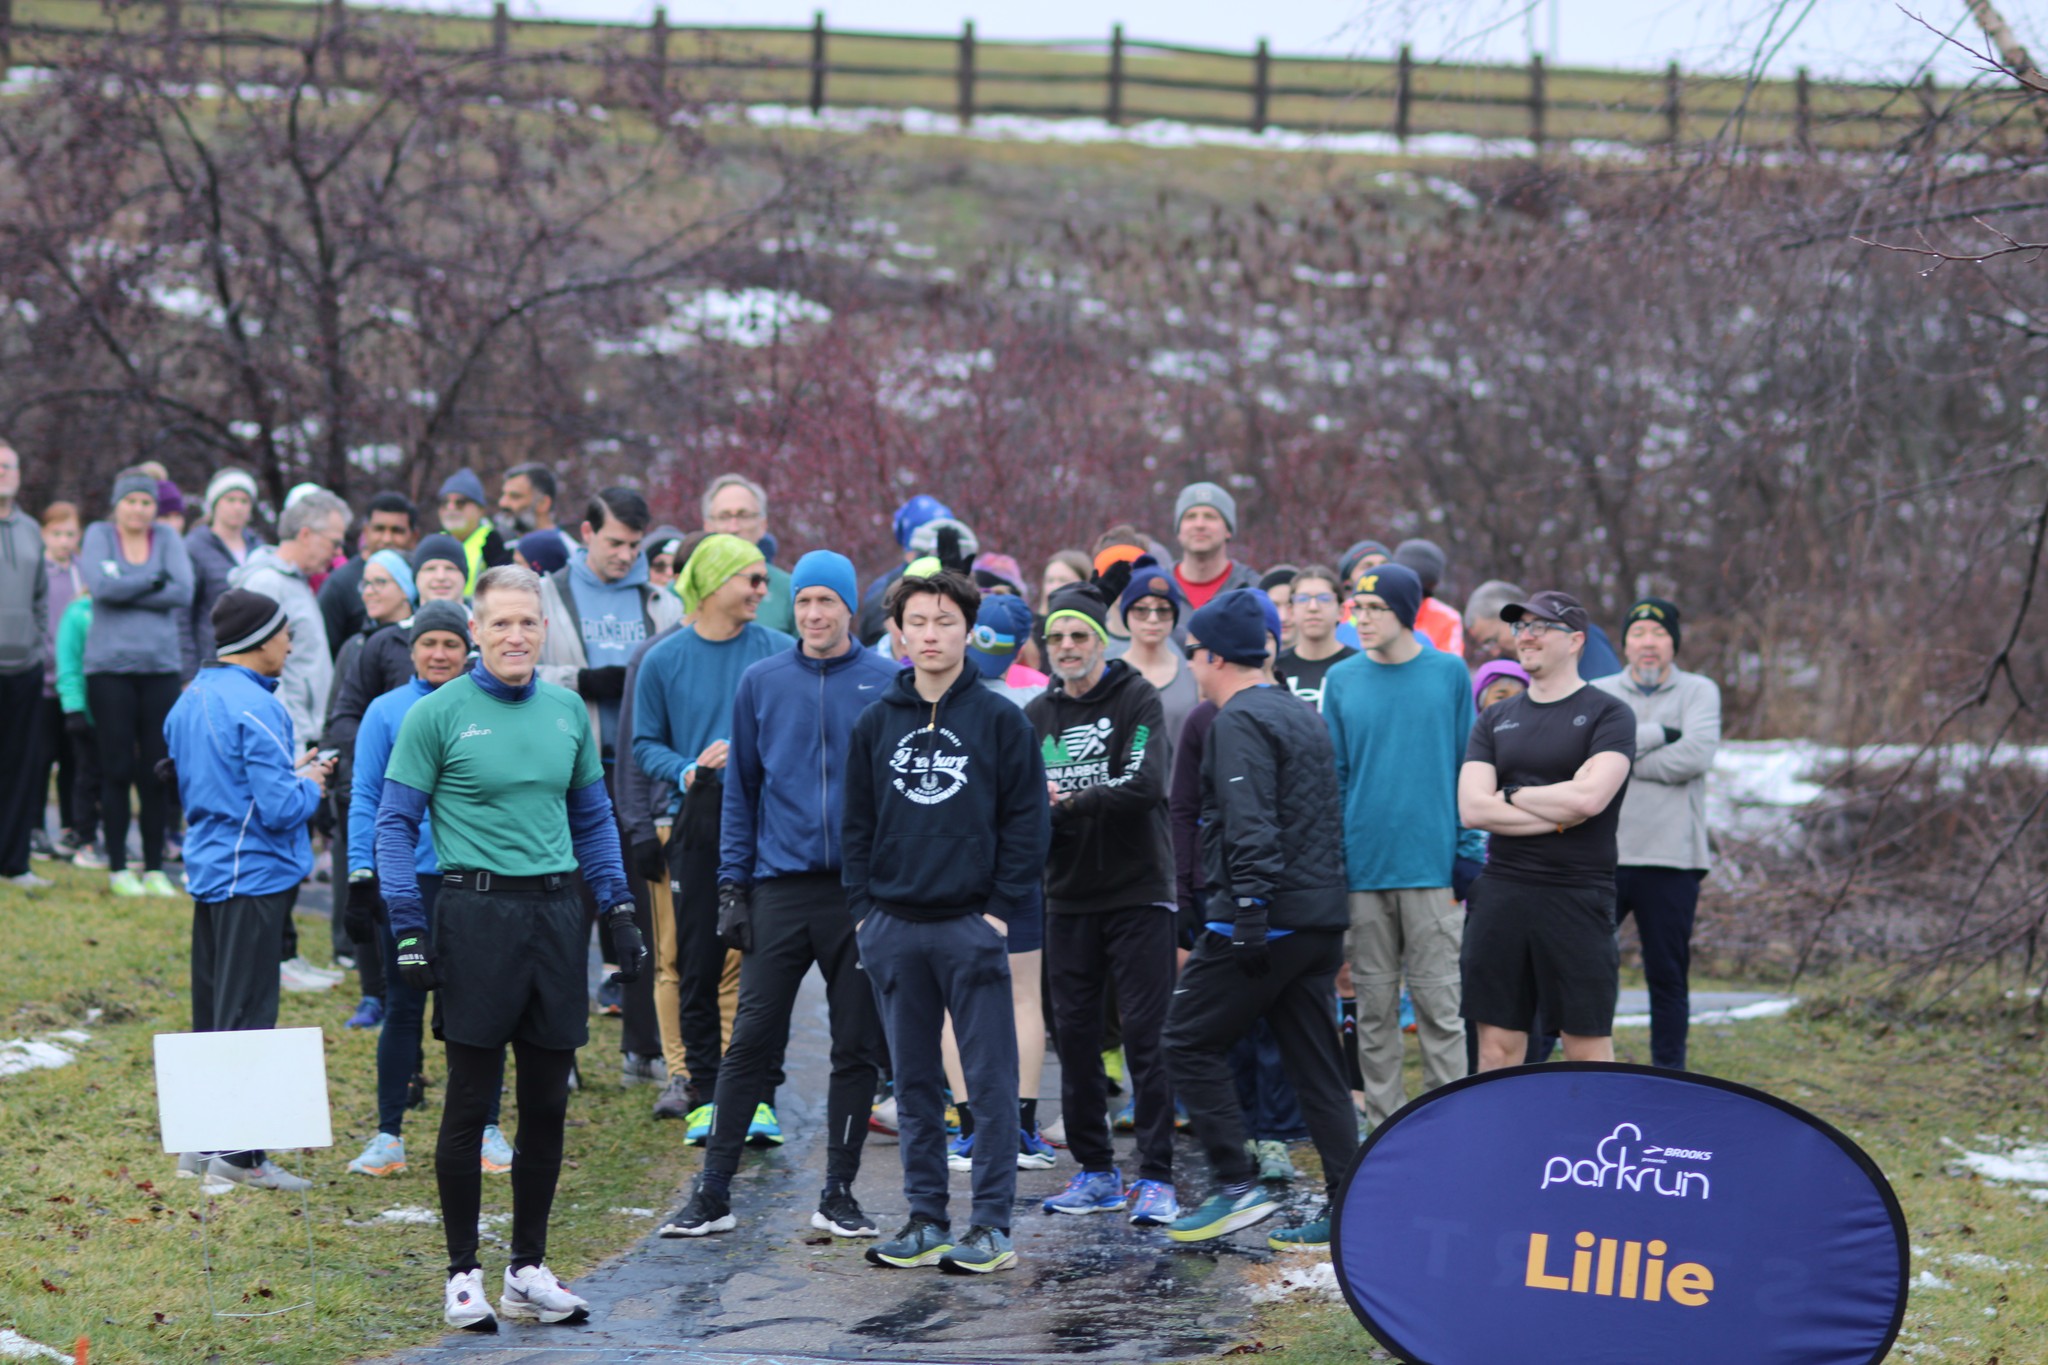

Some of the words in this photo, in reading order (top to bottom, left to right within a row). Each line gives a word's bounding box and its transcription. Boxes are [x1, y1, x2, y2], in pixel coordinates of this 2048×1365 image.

[1541, 1123, 1710, 1199] parkrun
[1663, 1147, 1713, 1160] BROOKS
[1525, 1231, 1714, 1306] Lillie
